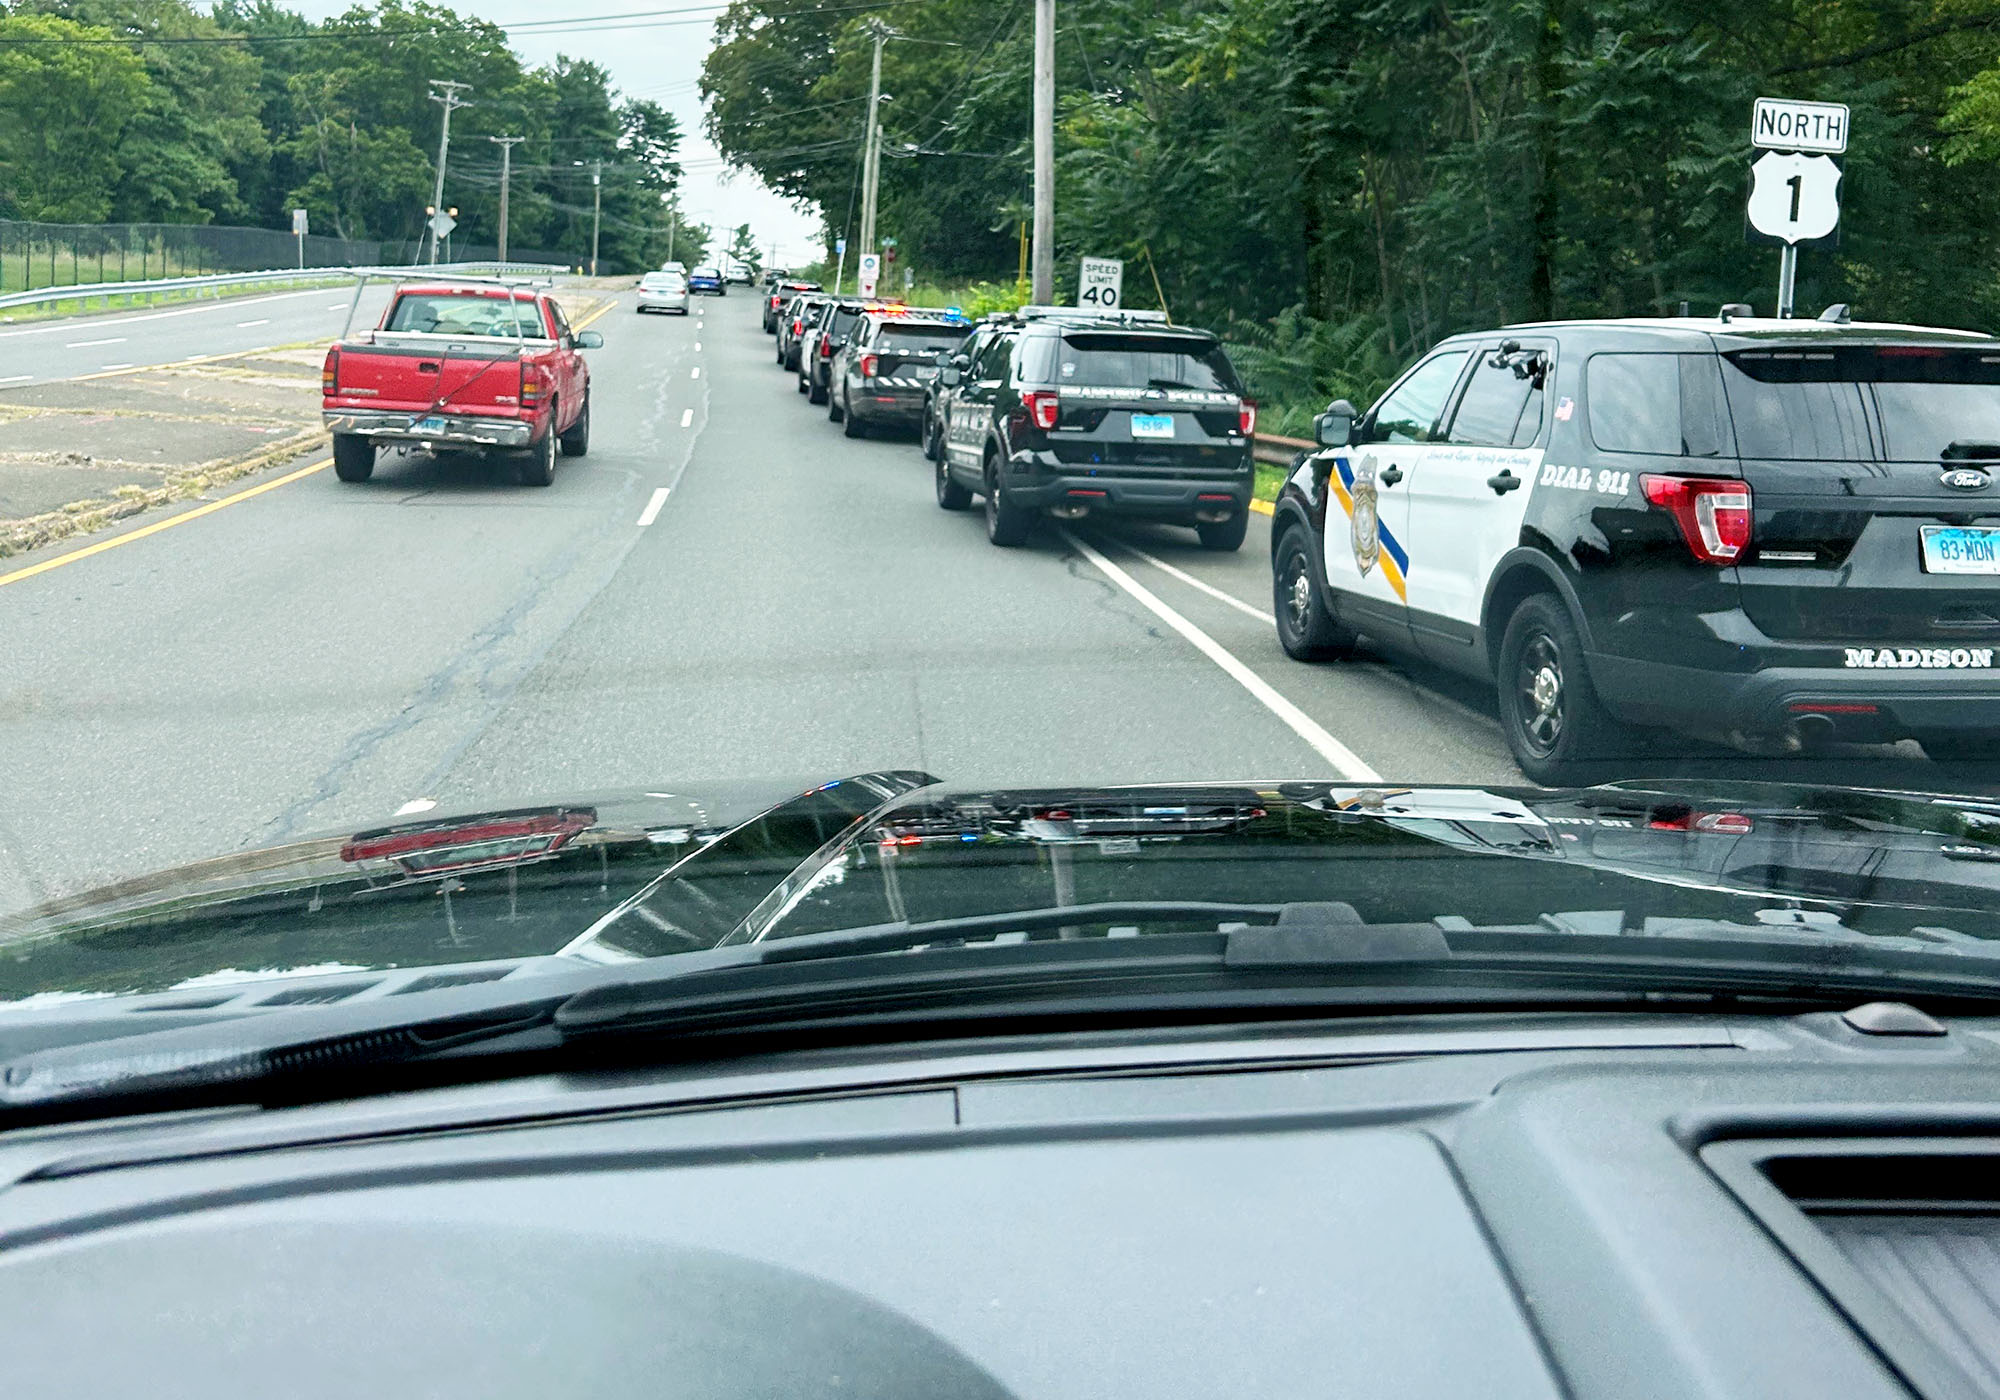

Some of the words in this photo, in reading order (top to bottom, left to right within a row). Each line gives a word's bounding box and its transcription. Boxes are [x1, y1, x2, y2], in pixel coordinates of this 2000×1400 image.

[1760, 109, 1841, 141] NORTH
[1786, 175, 1802, 222] 1
[1085, 264, 1118, 274] SPEED
[1088, 276, 1113, 284] LIMIT
[1083, 287, 1116, 305] 40
[1540, 464, 1592, 490] DIAL
[1597, 470, 1630, 495] 911
[1954, 472, 1981, 486] Ford
[1845, 648, 1993, 668] MADISON
